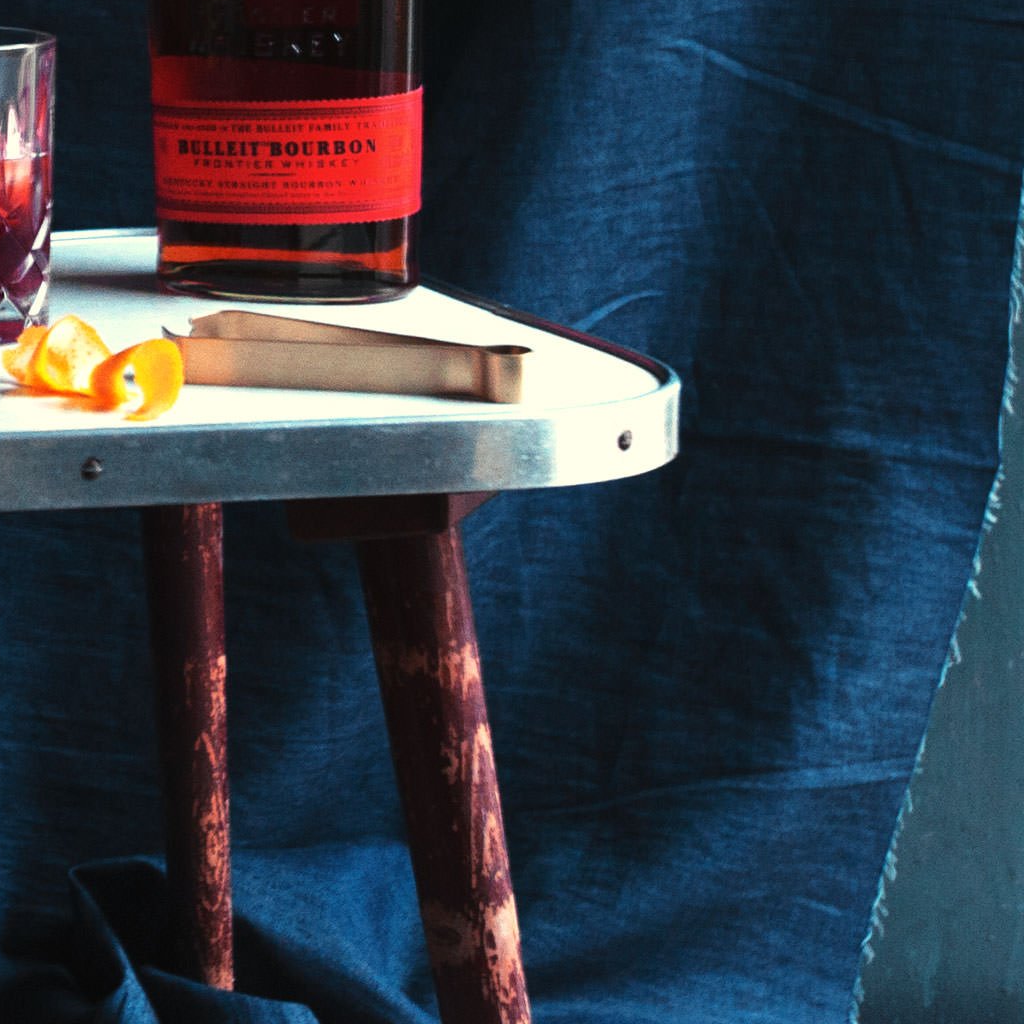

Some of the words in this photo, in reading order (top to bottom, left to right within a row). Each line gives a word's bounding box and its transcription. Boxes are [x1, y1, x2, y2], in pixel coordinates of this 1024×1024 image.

[178, 138, 259, 157] BULLEIT
[270, 138, 376, 157] BOURBON
[193, 159, 273, 170] FRONTIER
[282, 158, 359, 170] WHISKEY
